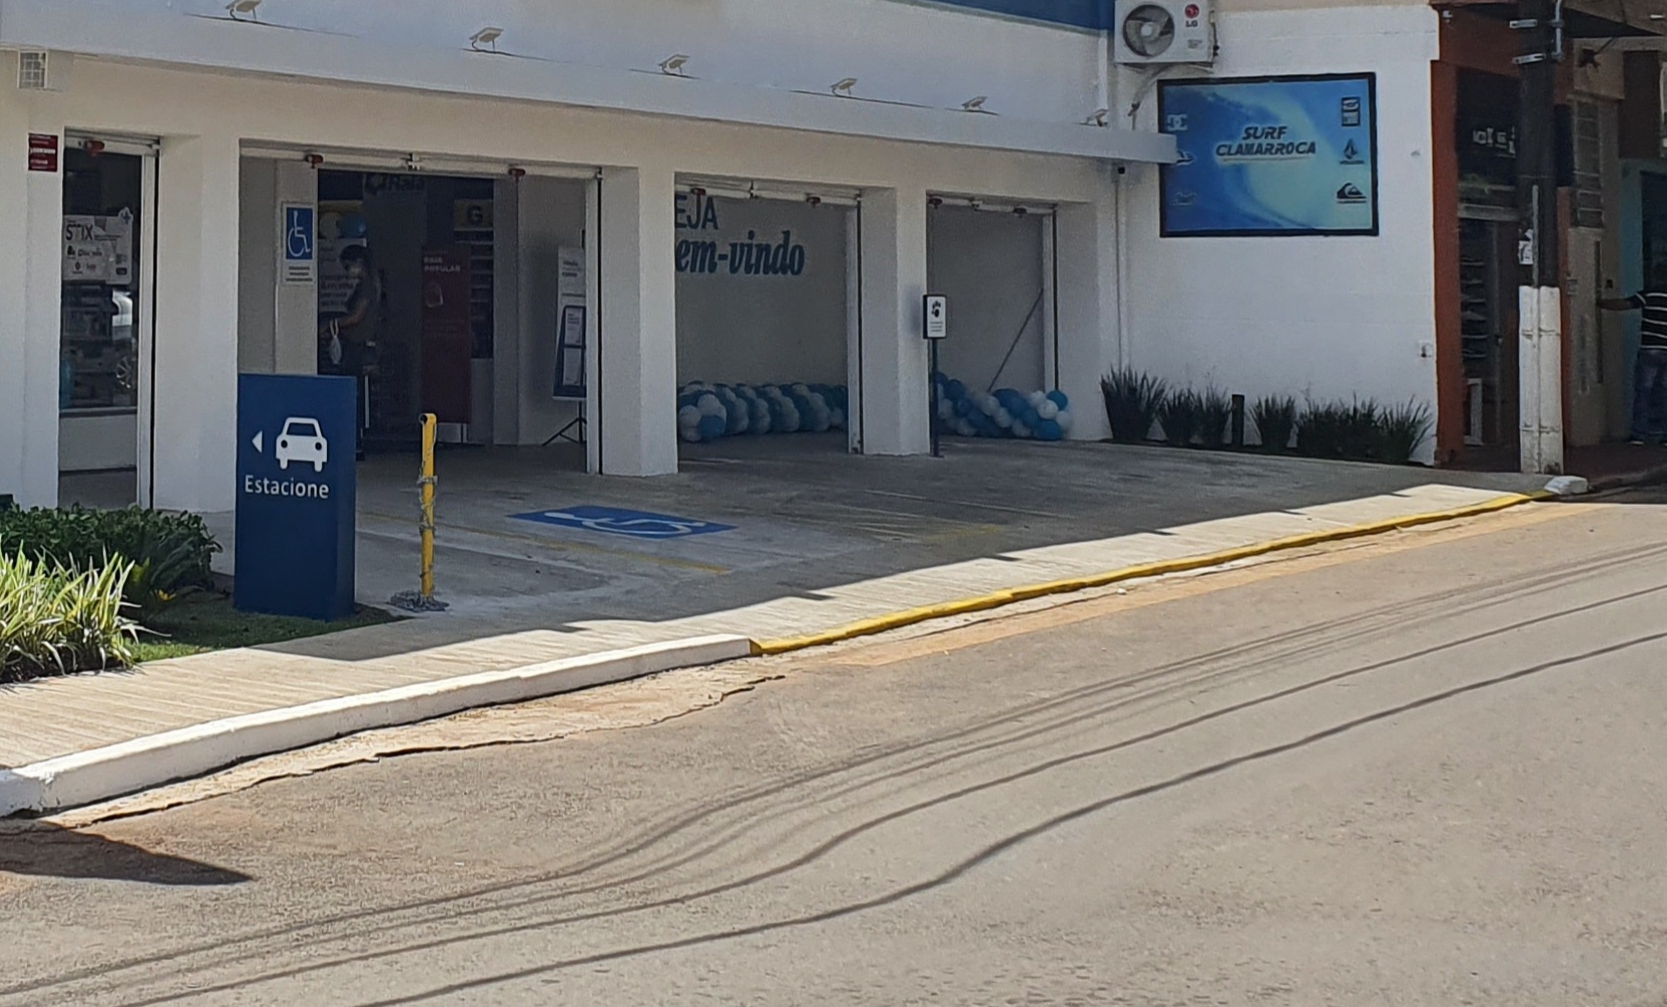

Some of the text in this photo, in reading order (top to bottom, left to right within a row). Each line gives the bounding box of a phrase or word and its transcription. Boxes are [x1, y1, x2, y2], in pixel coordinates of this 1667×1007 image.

[1185, 19, 1199, 28] LG
[1242, 126, 1288, 141] SURF
[1215, 141, 1317, 158] CLAMARROCA
[675, 229, 806, 276] em-vindo
[244, 474, 330, 499] Estacione
